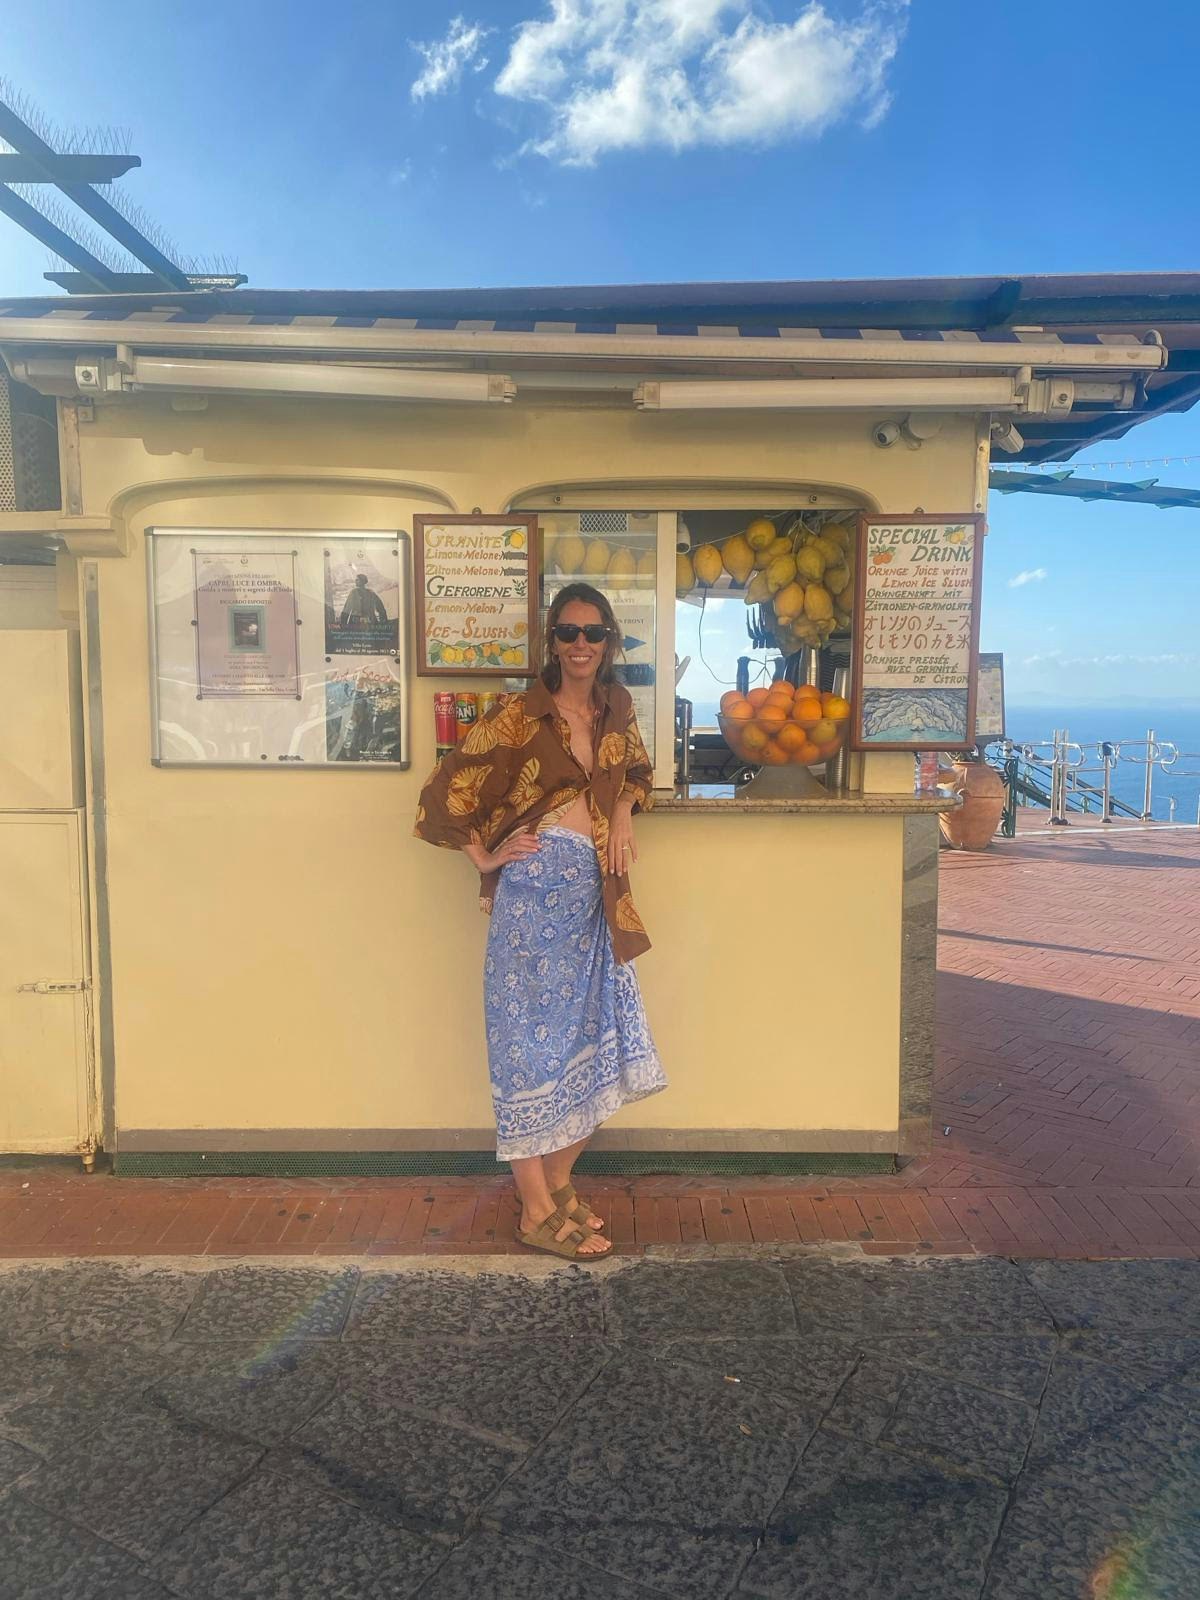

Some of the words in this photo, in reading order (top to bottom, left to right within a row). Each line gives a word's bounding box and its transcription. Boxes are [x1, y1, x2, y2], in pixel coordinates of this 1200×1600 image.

[868, 528, 941, 545] SPECIAL
[909, 545, 973, 562] DRINK
[868, 565, 909, 576] ORANGE
[426, 575, 513, 598] GEFRORENE
[881, 577, 919, 588] LEMON
[921, 577, 937, 588] ICE
[942, 577, 973, 588] SLUSH
[863, 653, 905, 665] ORANGE
[913, 675, 926, 684] DE
